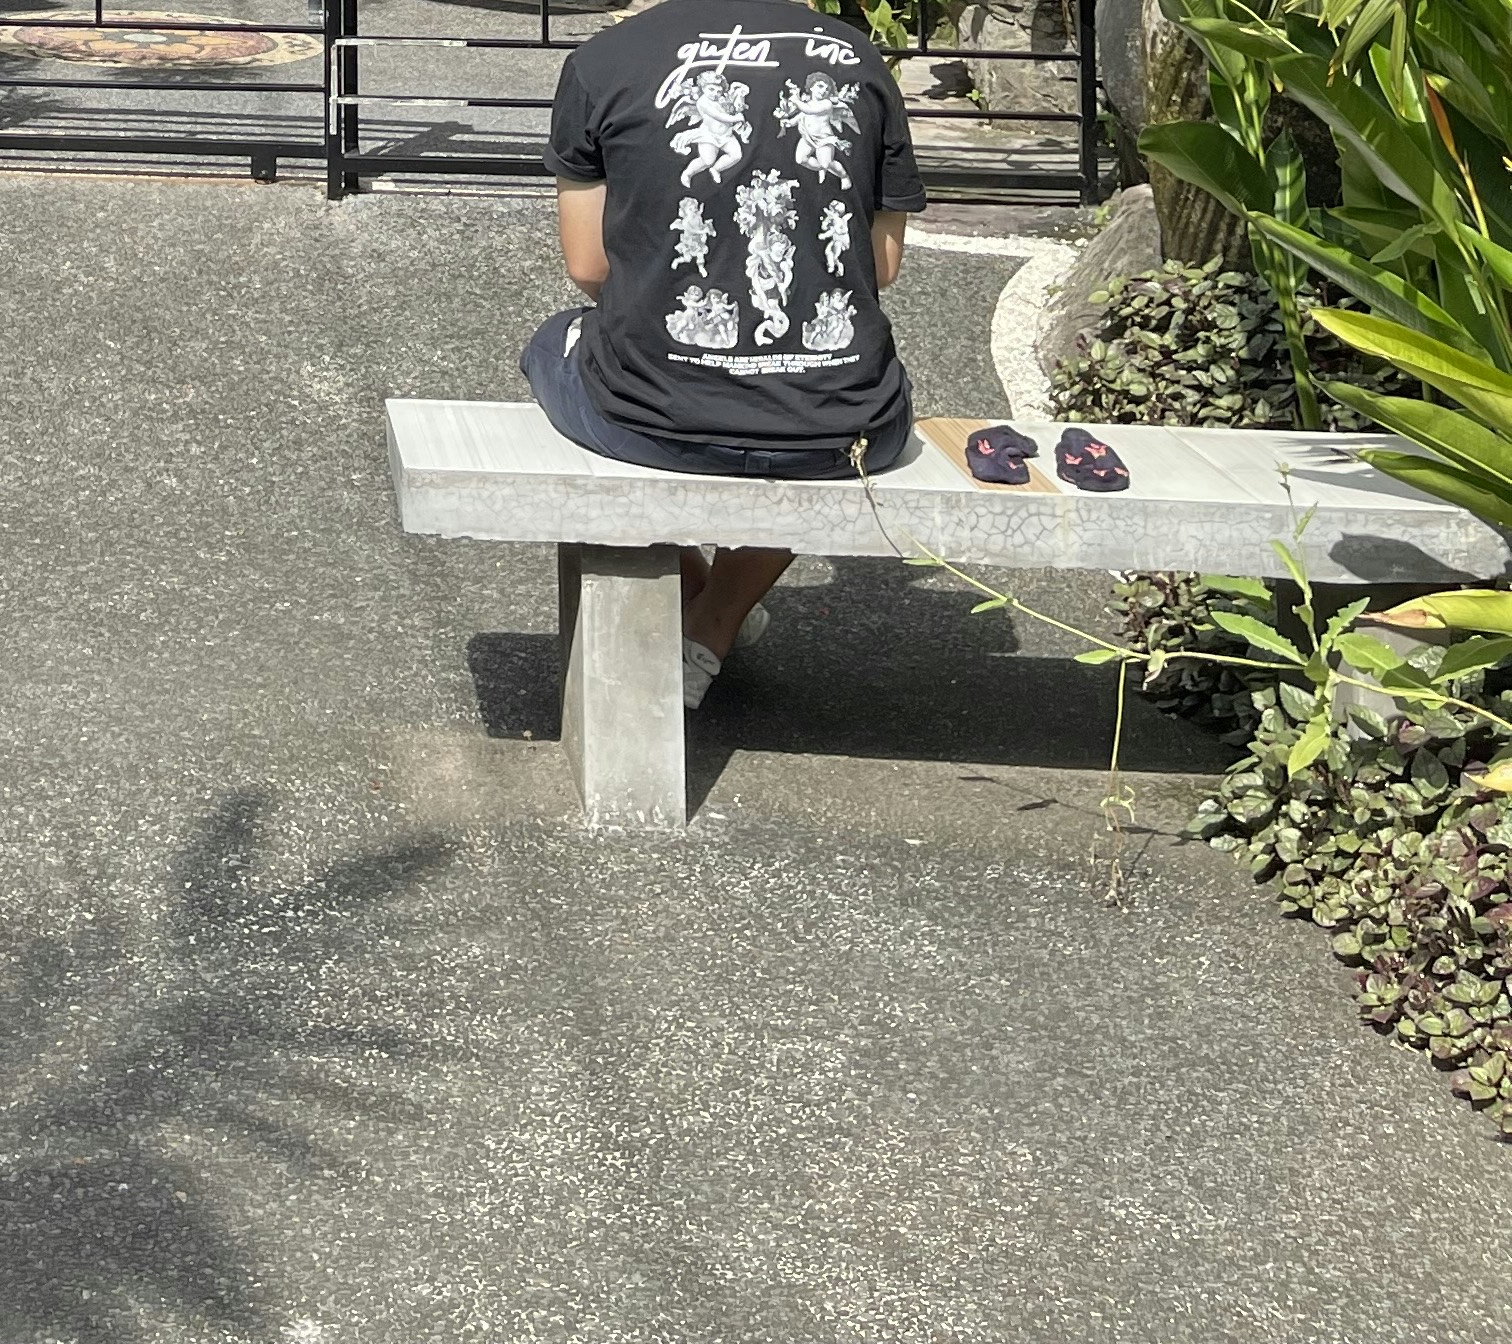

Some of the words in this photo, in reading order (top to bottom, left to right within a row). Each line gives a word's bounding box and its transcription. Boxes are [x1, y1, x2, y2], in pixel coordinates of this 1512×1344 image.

[655, 25, 779, 109] guten
[806, 27, 861, 64] inc
[667, 353, 688, 362] SENT
[689, 356, 700, 365] TO
[701, 358, 721, 367] HELP
[782, 360, 821, 368] THROUGH
[702, 353, 733, 362] ANGELS
[795, 353, 832, 361] ETERNITY
[729, 367, 759, 376] CANNOT
